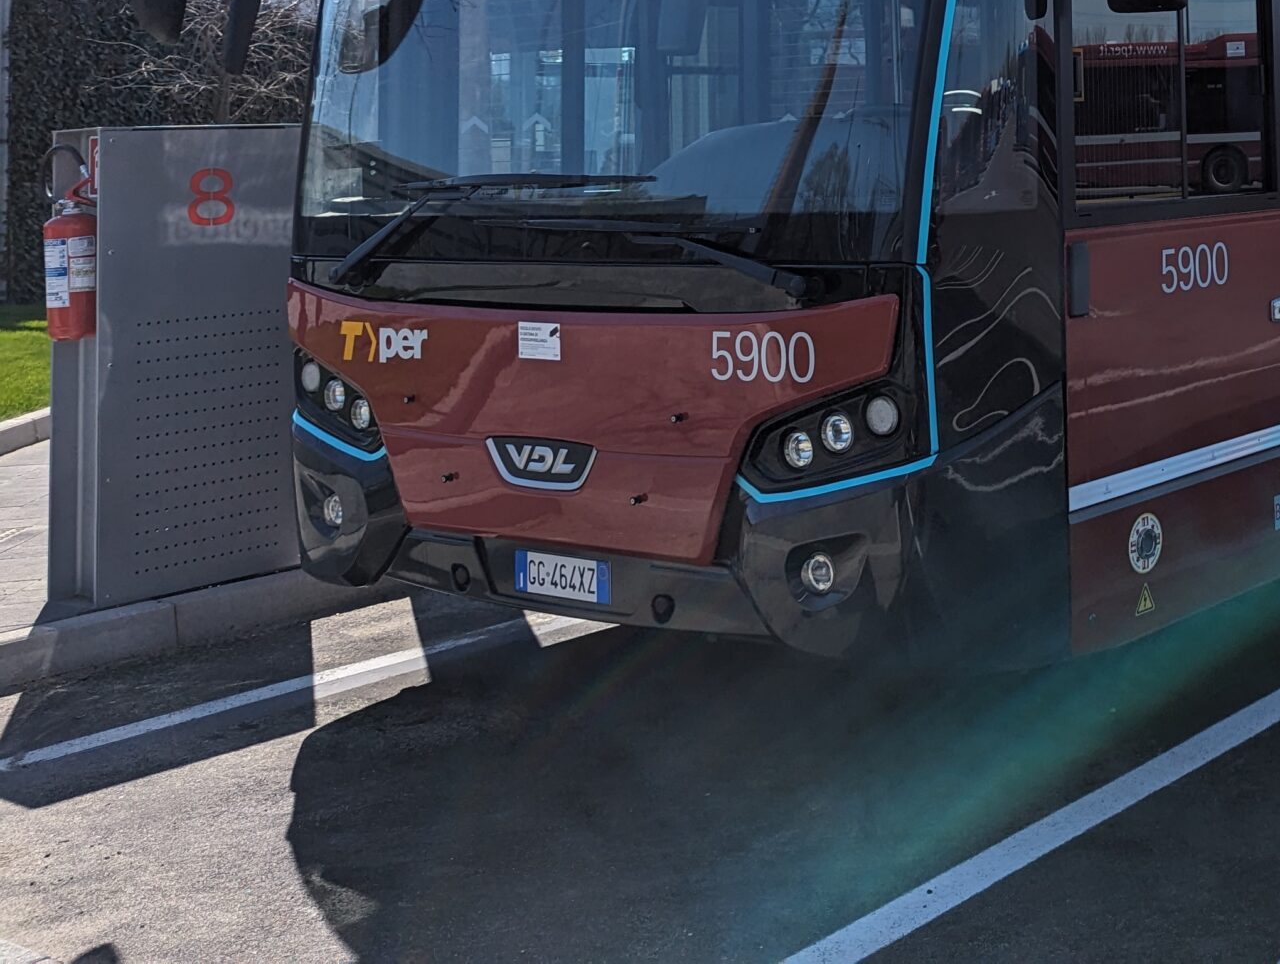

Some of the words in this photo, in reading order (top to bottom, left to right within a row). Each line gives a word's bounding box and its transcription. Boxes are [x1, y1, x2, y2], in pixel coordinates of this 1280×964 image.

[187, 167, 235, 226] 8
[1161, 240, 1230, 294] 5900
[711, 330, 816, 383] 5900
[505, 443, 576, 475] VDL
